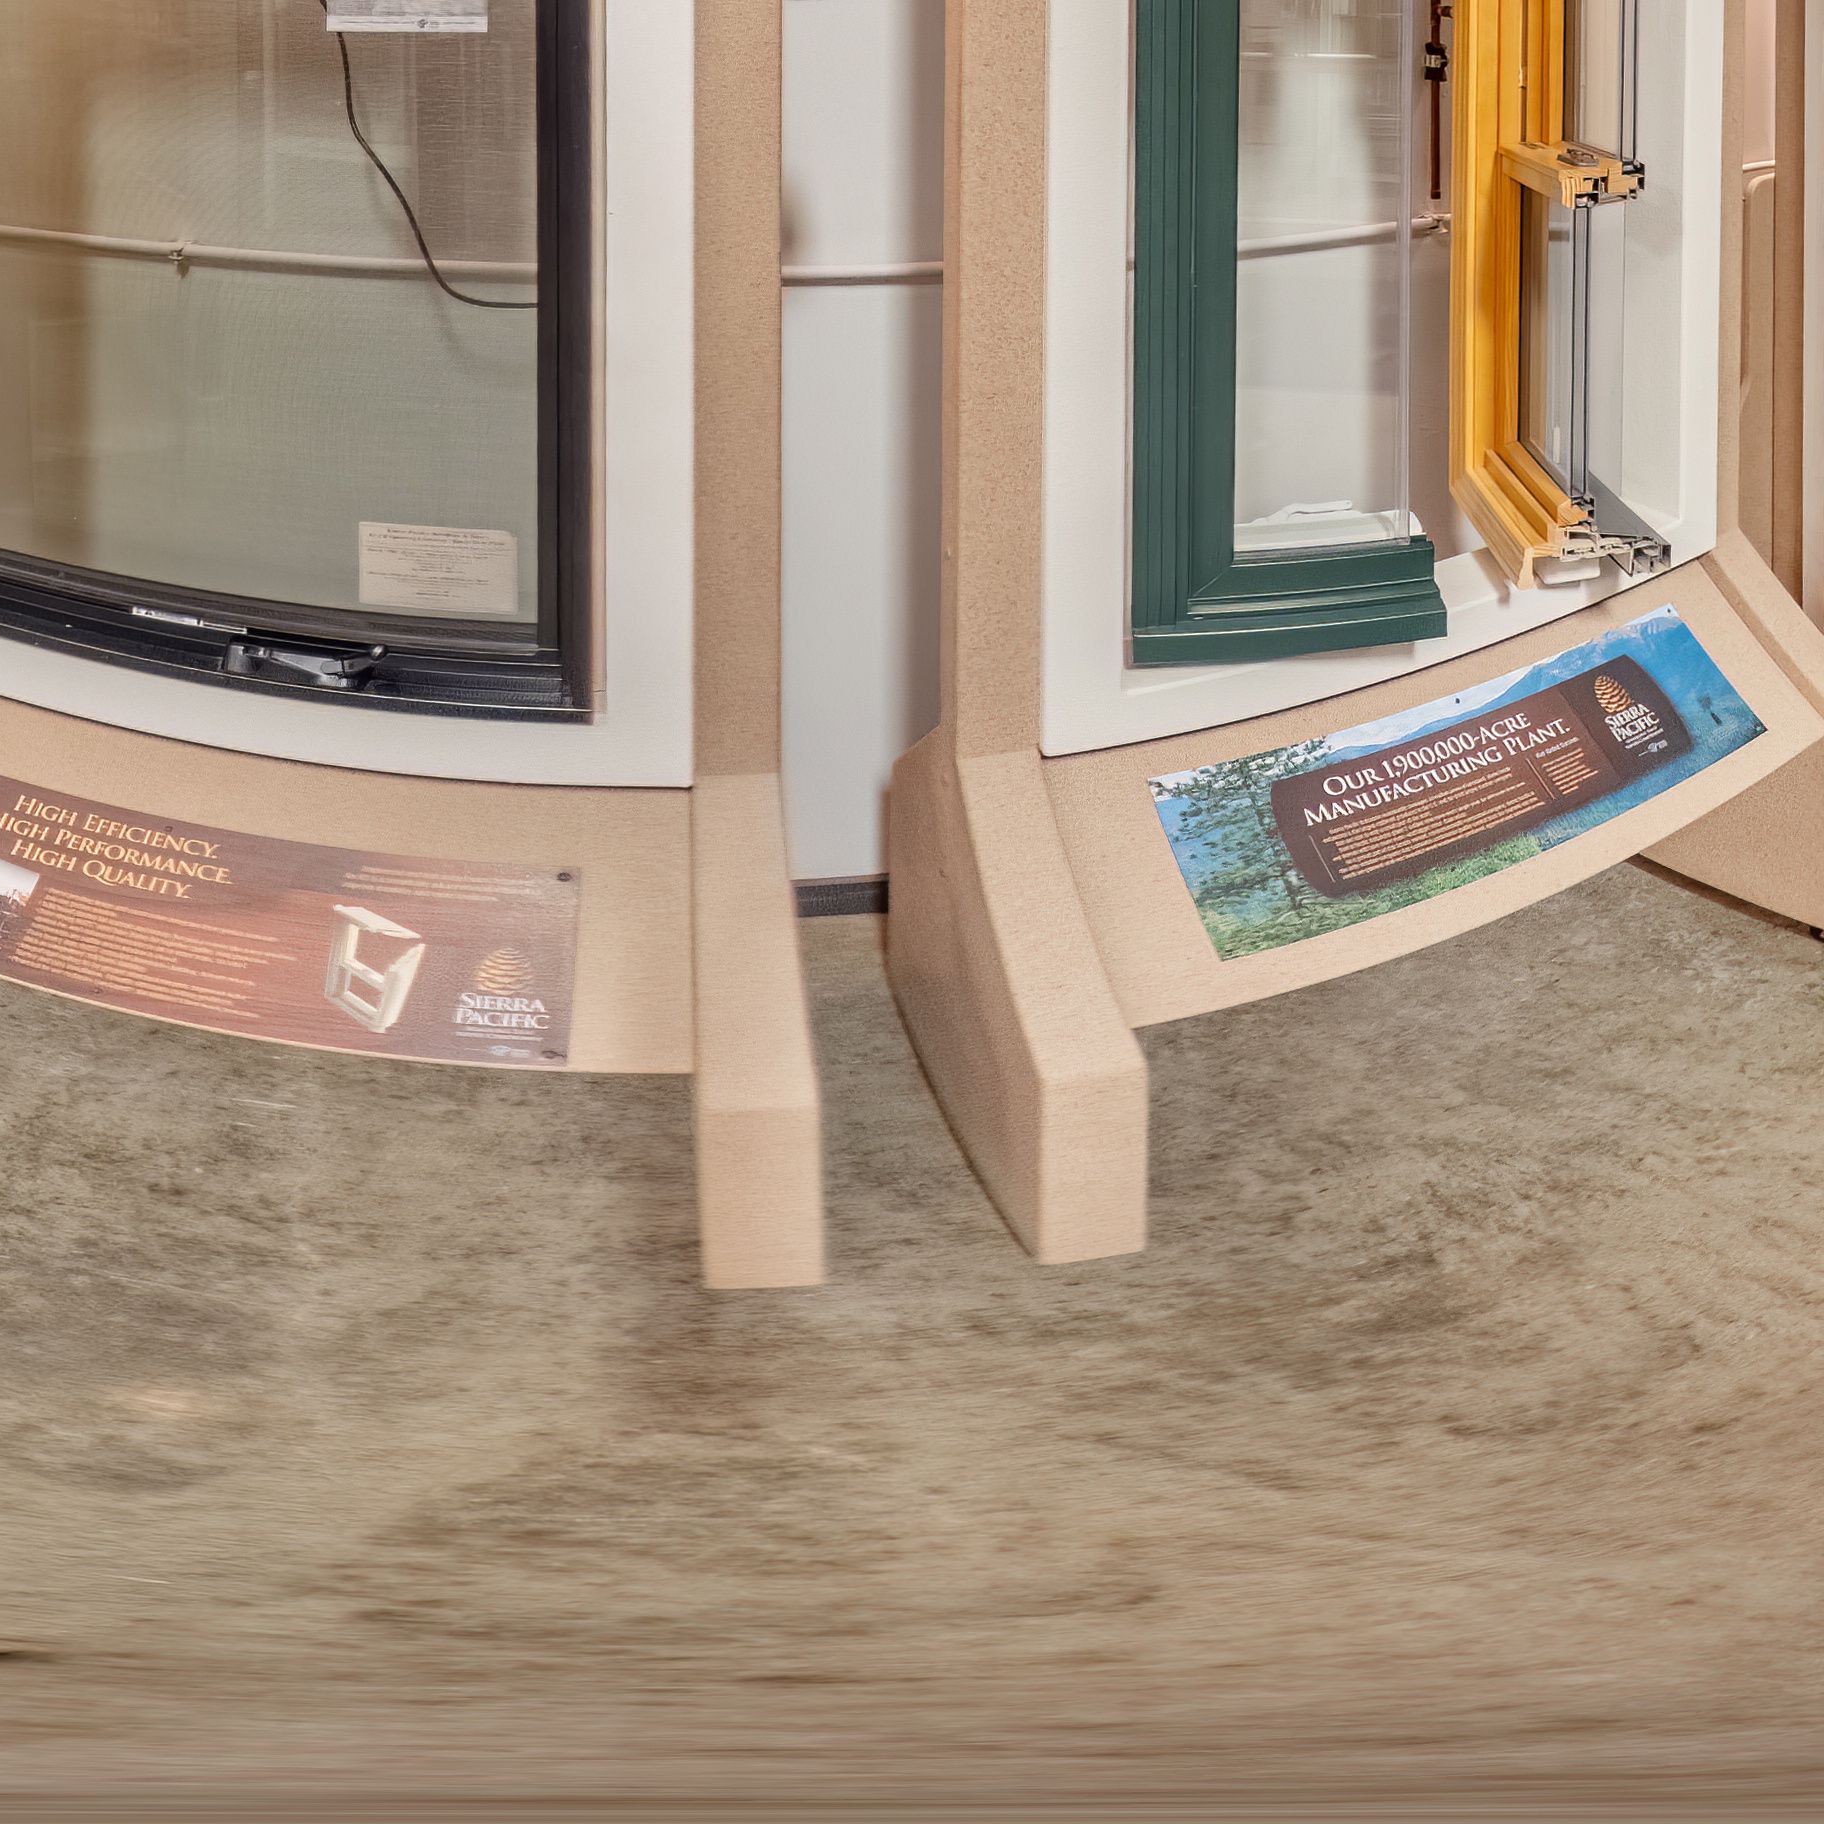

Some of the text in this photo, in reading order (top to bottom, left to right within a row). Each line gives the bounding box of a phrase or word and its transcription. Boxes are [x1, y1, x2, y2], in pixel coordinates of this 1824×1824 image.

[1605, 703, 1650, 730] SIERRA
[1609, 712, 1660, 742] PACIFIC
[1323, 768, 1384, 796] OUR
[1381, 712, 1531, 778] 1,900,000-ACRE
[1303, 745, 1503, 827] MANUFACTURING
[1502, 718, 1571, 756] PLANT.
[14, 795, 221, 859] HIGH EFFICIENCY.
[10, 839, 77, 871] HIGH
[459, 992, 546, 1013] SIERRA
[452, 1008, 549, 1029] PACIFIC
